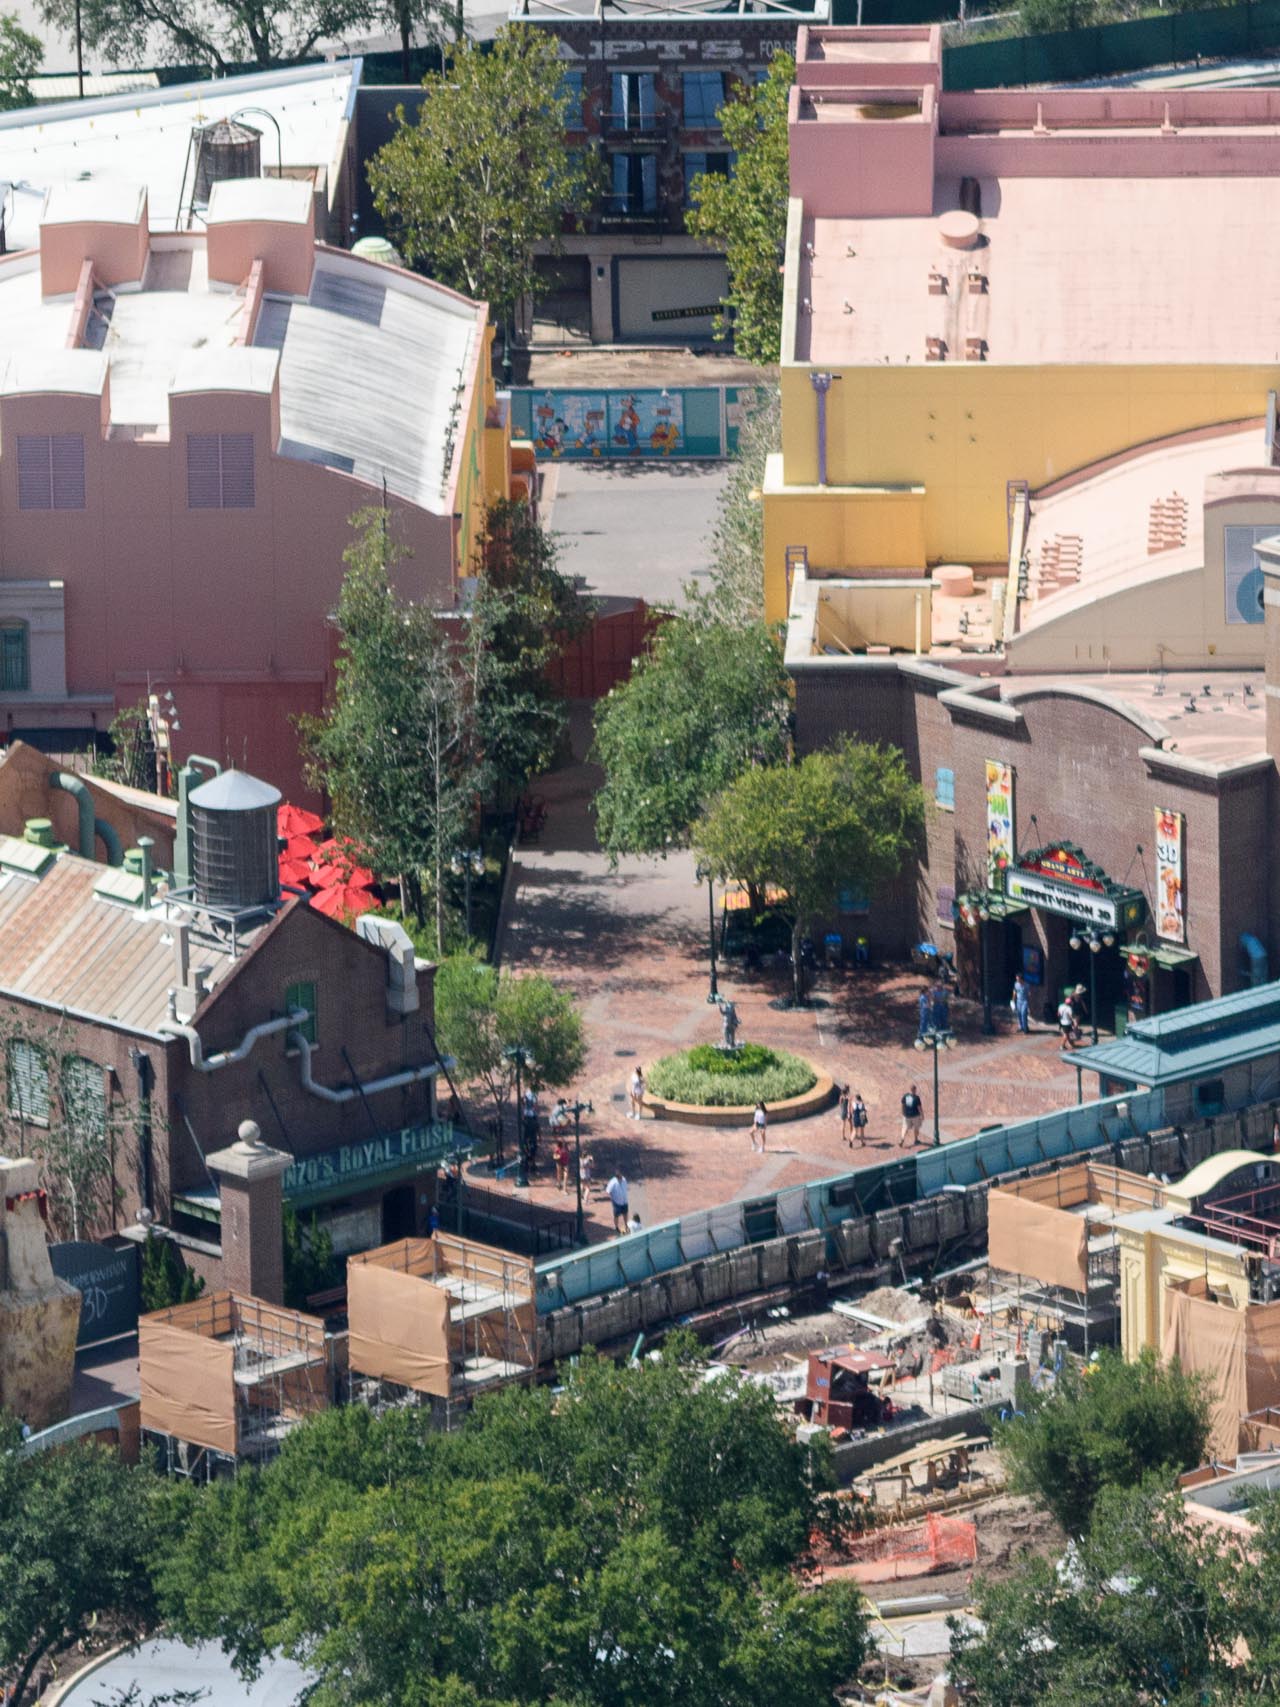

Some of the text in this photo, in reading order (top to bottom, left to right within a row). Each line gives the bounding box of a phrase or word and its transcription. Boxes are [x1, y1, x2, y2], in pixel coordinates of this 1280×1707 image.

[1097, 908, 1111, 920] 3D
[281, 1120, 454, 1189] NZO'S ROYAL FLUSH
